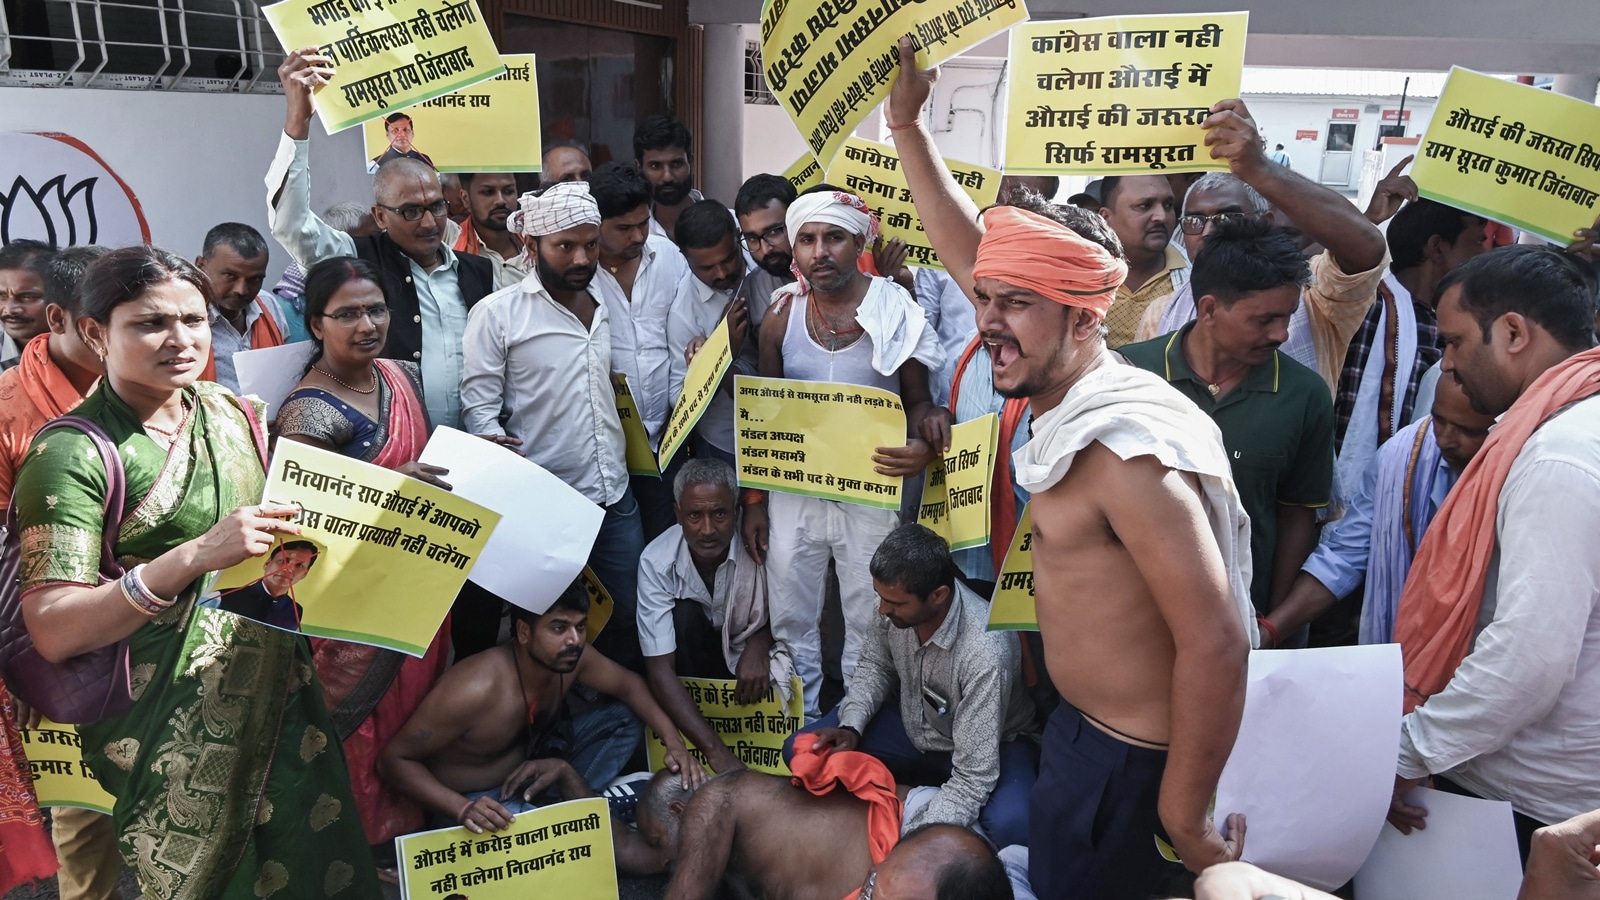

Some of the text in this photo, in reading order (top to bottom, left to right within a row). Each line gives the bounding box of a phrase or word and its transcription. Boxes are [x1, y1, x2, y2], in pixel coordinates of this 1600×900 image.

[408, 8, 438, 40] नही
[432, 0, 476, 32] चलेगा
[942, 10, 962, 38] को
[916, 16, 948, 54] औराई
[1031, 24, 1224, 53] कांग्रेस वाला नही
[767, 32, 810, 92] करेगी
[1037, 62, 1213, 90] चलेगा औराई में
[340, 46, 474, 108] रामसूरत राय जिंदाबाद
[788, 51, 839, 118] भाजपा
[858, 71, 876, 96] को
[469, 95, 491, 108] राय
[830, 98, 849, 126] नही
[818, 110, 840, 139] दिया
[1025, 104, 1092, 129] औराई
[1097, 103, 1130, 127] की
[1446, 108, 1501, 139] औराई
[1500, 121, 1526, 144] की
[845, 146, 900, 171] कांग्रेस
[1045, 141, 1196, 170] सिर्फ रामसूरत
[789, 158, 820, 187] नित्यानं
[846, 174, 897, 199] चलेगा
[1425, 141, 1600, 210] राम सूरत कुमार जिंदाबाद
[887, 212, 913, 230] की
[740, 387, 759, 396] अगर
[760, 388, 785, 399] औराई
[787, 388, 795, 399] से
[797, 391, 830, 403] रामसूरत
[832, 393, 844, 403] जी
[846, 394, 862, 404] नही
[740, 428, 805, 443] मंडल अध्यक्ष
[741, 446, 768, 458] मंडल
[958, 444, 981, 471] सिर्फ
[742, 464, 768, 476] मंडल
[771, 466, 781, 478] के
[784, 470, 804, 482] सभी
[807, 473, 822, 485] पद
[825, 473, 834, 486] से
[838, 478, 861, 491] मुक्त
[282, 459, 482, 539] नित्यानंद राय औराई में आपको
[949, 485, 983, 510] जिंदाबाद
[324, 515, 359, 539] वाला
[357, 522, 402, 548] प्रत्यासी
[400, 530, 427, 556] नही
[703, 683, 718, 704] को
[744, 711, 765, 733] नही
[767, 711, 800, 734] चलेगा
[737, 740, 782, 768] जिंदाबाद
[414, 813, 601, 870] औराई में करोड़ वाला प्रत्यासी
[430, 845, 592, 894] नही चलेगा नित्यानंद राय
